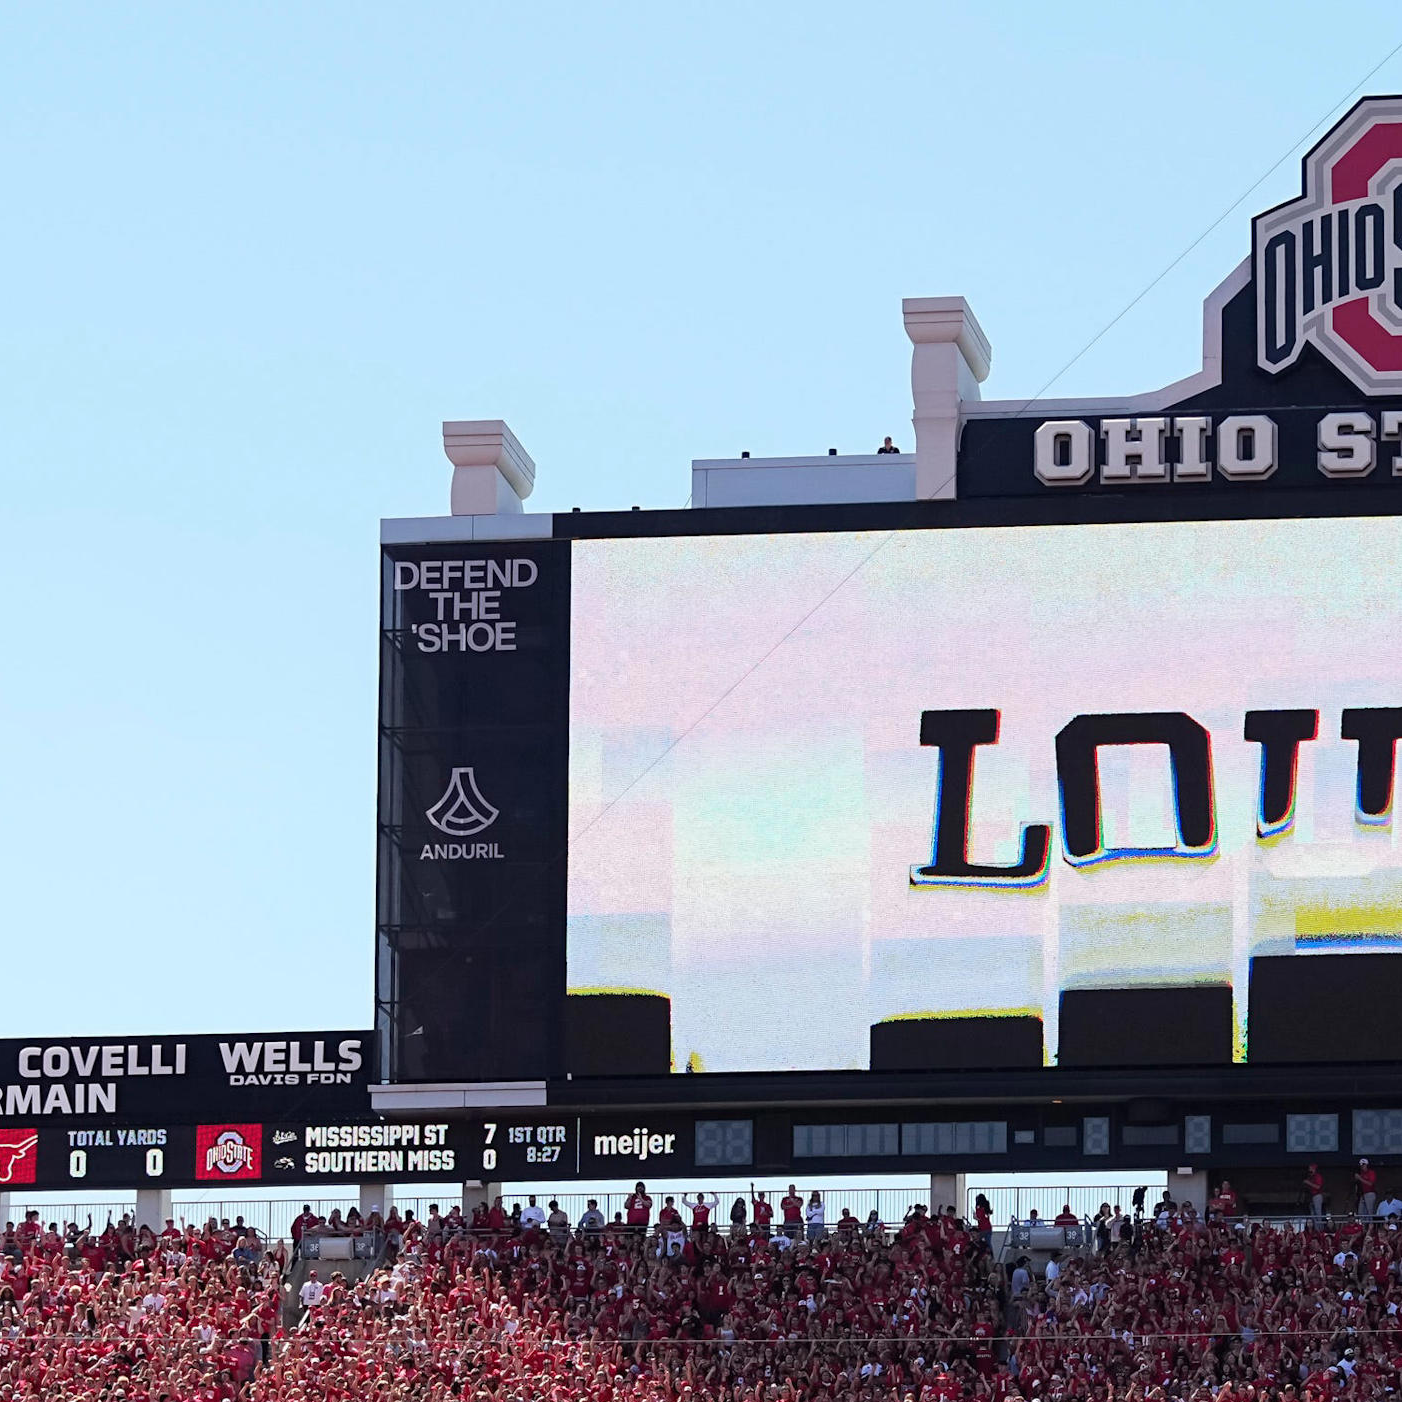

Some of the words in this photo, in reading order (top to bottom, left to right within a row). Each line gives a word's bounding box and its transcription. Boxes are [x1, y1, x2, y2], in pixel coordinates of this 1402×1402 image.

[1034, 412, 1279, 486] OHIO
[394, 558, 538, 591] DEFEND
[429, 590, 501, 621] THE
[411, 621, 517, 653] 'SHOE
[419, 842, 505, 860] ANDURIL
[18, 1043, 187, 1080] COVELLI
[219, 1039, 363, 1074] WELLS
[229, 1074, 300, 1086] DAVIS
[306, 1072, 352, 1085] FDN
[68, 1130, 113, 1147] TOTAL
[117, 1128, 167, 1145] YARDS
[305, 1125, 421, 1147] MISSISSIPPI
[424, 1124, 449, 1146] ST
[484, 1123, 497, 1145] 7
[508, 1127, 533, 1144] 1ST
[536, 1126, 566, 1145] QTR
[594, 1128, 676, 1161] meijer
[70, 1149, 87, 1179] 0
[146, 1148, 164, 1178] 0
[304, 1150, 404, 1173] SOUTHERN
[408, 1148, 455, 1172] MISS
[483, 1148, 496, 1171] 0
[527, 1145, 561, 1163] 8:27
